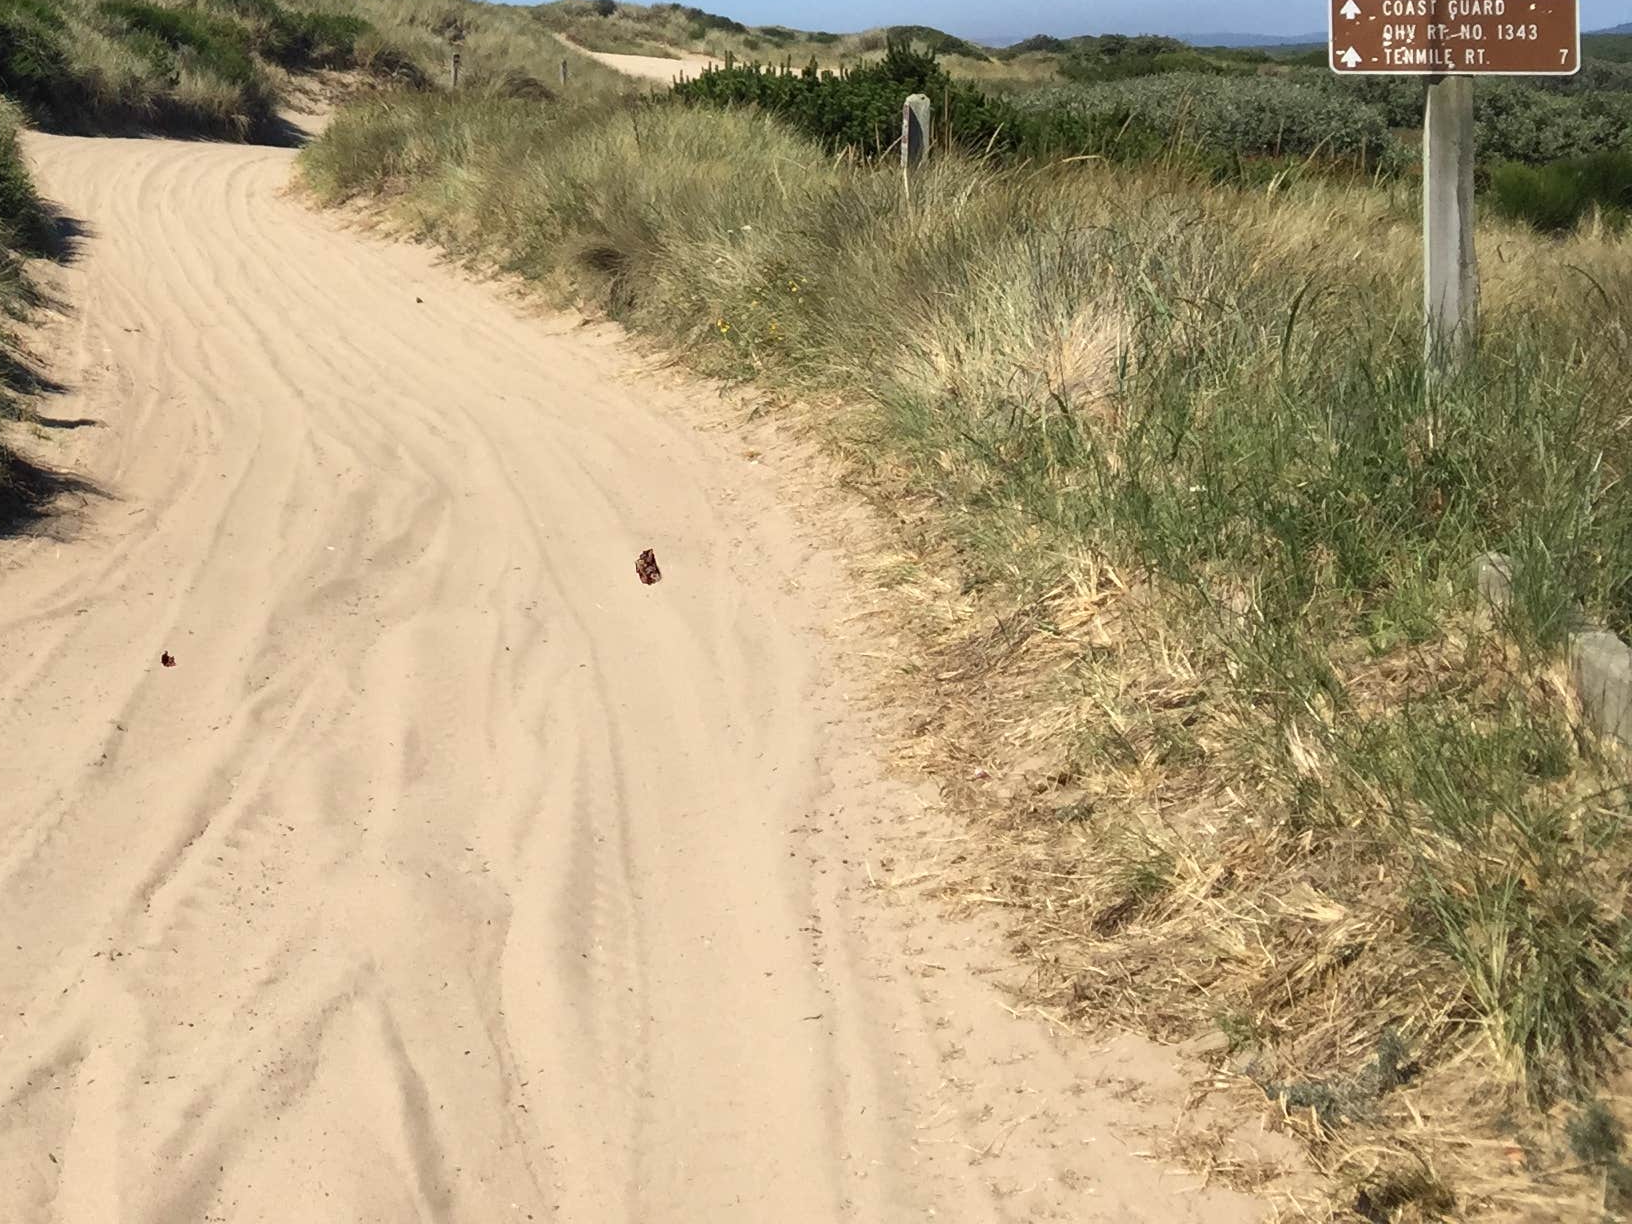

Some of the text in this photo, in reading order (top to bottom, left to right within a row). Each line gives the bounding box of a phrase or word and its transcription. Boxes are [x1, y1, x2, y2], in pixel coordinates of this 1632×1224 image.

[1382, 0, 1505, 16] COAST GUARD
[1383, 24, 1416, 40] OHV
[1460, 24, 1487, 40] NO.
[1498, 25, 1538, 40] 1343
[1384, 49, 1569, 65] TENMILE RT. 7
